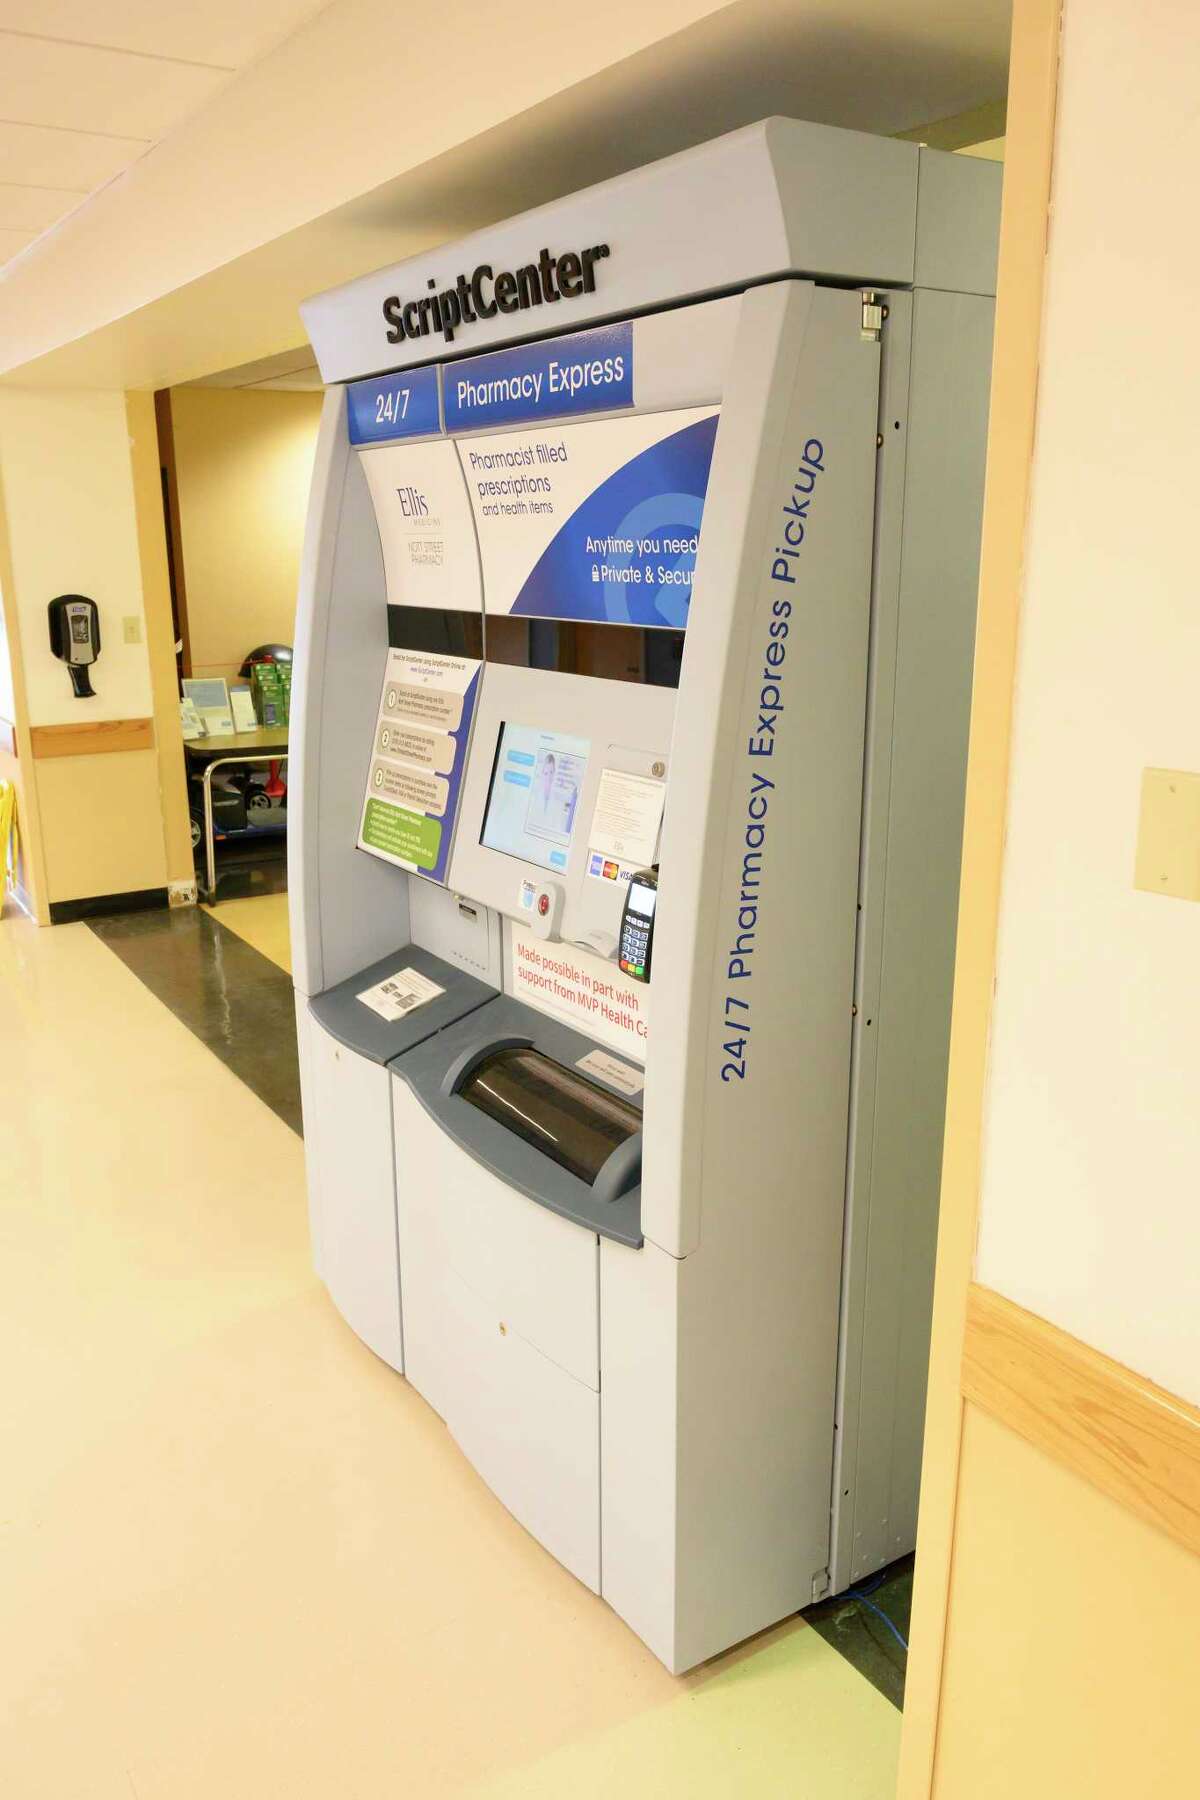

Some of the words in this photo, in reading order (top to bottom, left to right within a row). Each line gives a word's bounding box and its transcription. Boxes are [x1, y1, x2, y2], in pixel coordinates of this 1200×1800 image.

[457, 371, 544, 409] Pharmacy
[548, 355, 625, 397] Express
[375, 389, 410, 424] 24/7
[469, 446, 535, 471] Pharmacist
[535, 441, 568, 466] filled
[396, 487, 429, 517] Ellis
[477, 475, 552, 500] prescriptions
[482, 503, 500, 517] and
[500, 500, 528, 517] health
[528, 499, 554, 515] items
[770, 438, 825, 584] Pickup
[585, 535, 634, 555] Anytime
[636, 539, 660, 556] you
[663, 534, 698, 554] need
[601, 565, 642, 584] Private
[645, 567, 655, 584] &
[747, 600, 793, 758] Express
[727, 772, 776, 980] Pharmacy
[517, 943, 541, 964] Made
[542, 954, 581, 984] possible
[581, 970, 591, 987] in
[593, 979, 614, 1001] part
[616, 991, 639, 1011] with
[517, 966, 554, 991] support
[554, 979, 576, 1003] from
[577, 991, 599, 1012] MVP
[601, 1003, 634, 1032] Health
[720, 996, 751, 1083] 24/7
